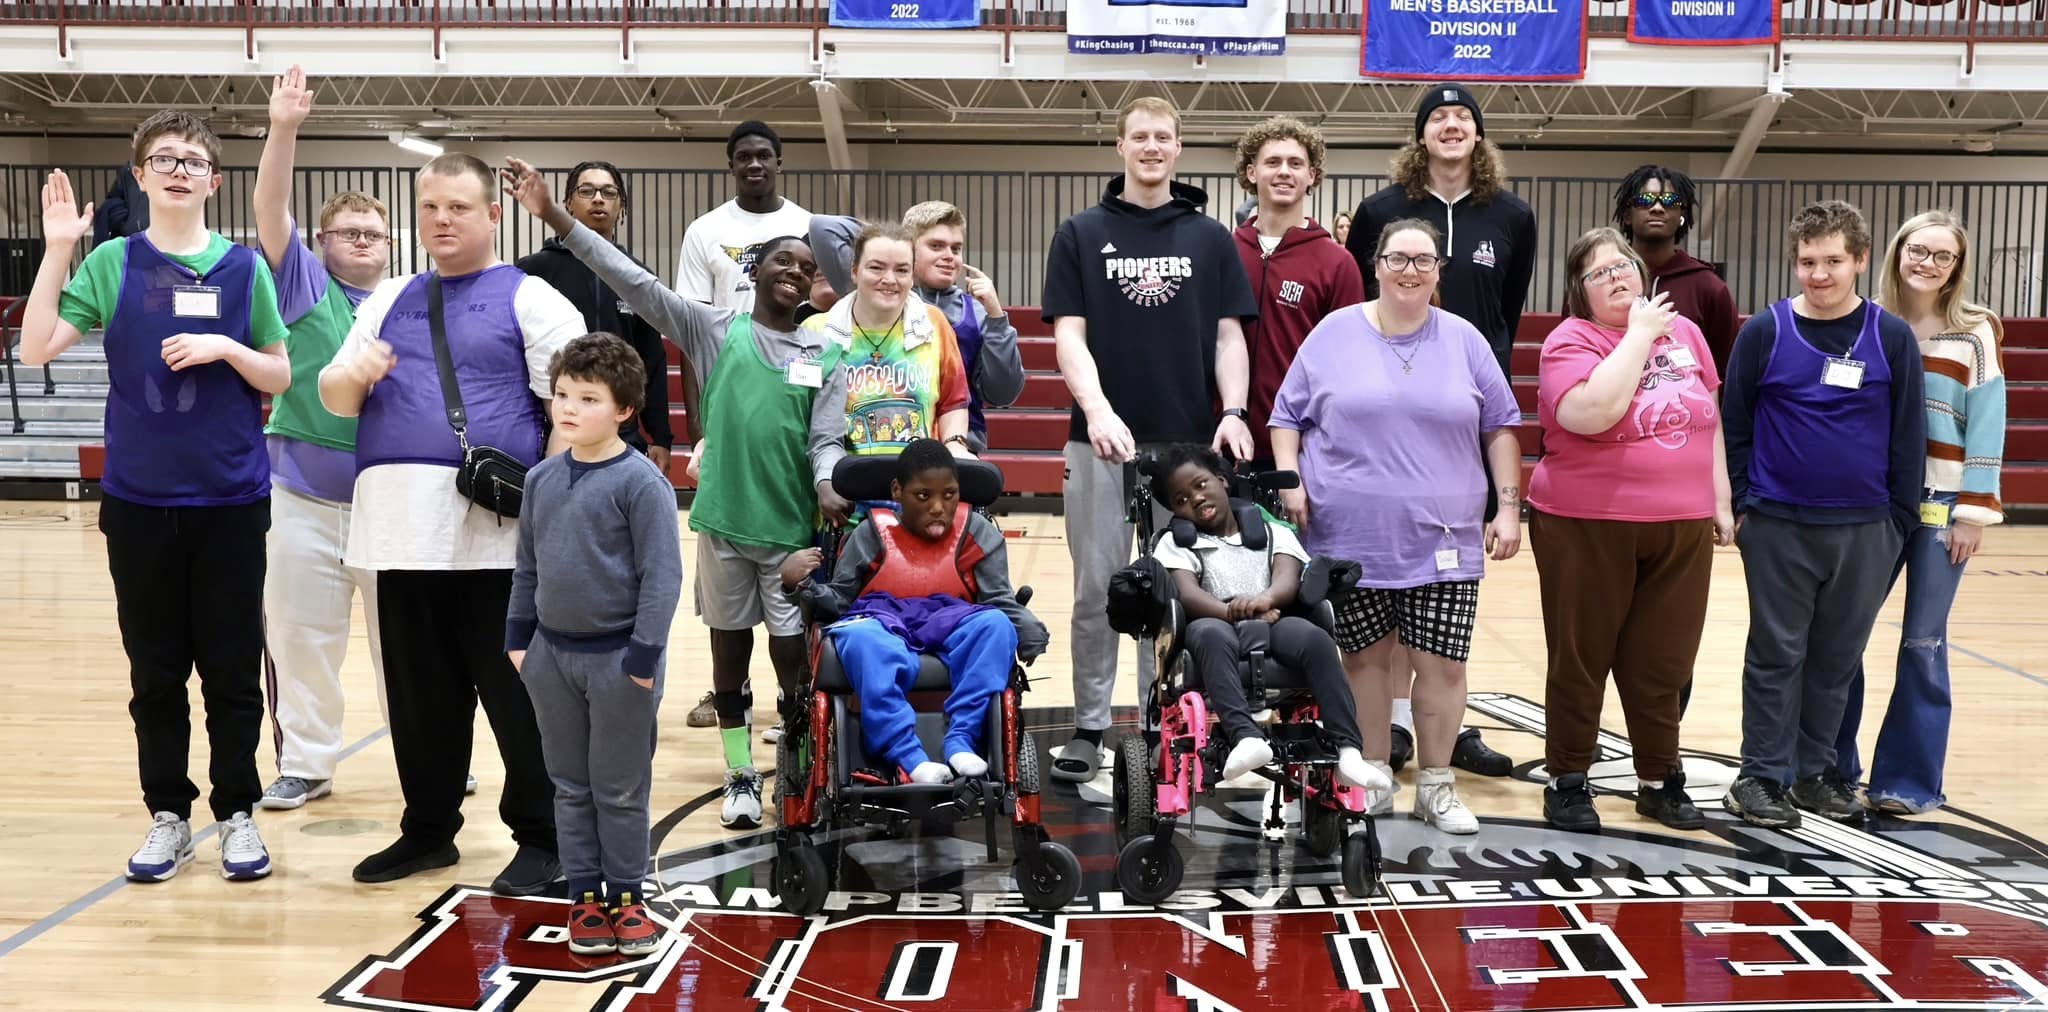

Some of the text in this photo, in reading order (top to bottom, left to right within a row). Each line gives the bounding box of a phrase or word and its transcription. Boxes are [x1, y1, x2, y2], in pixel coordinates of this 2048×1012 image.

[890, 3, 919, 18] 2022
[1390, 0, 1558, 13] MEN'S BASKETBALL
[1671, 1, 1735, 16] DIVISION II
[1155, 18, 1196, 27] est. 1968
[1430, 21, 1517, 36] DIVISION II
[1075, 39, 1279, 51] #KingChasing thenccaa.org #PlayForHim
[1453, 45, 1492, 58] 2022
[1105, 256, 1192, 279] PIONEERS
